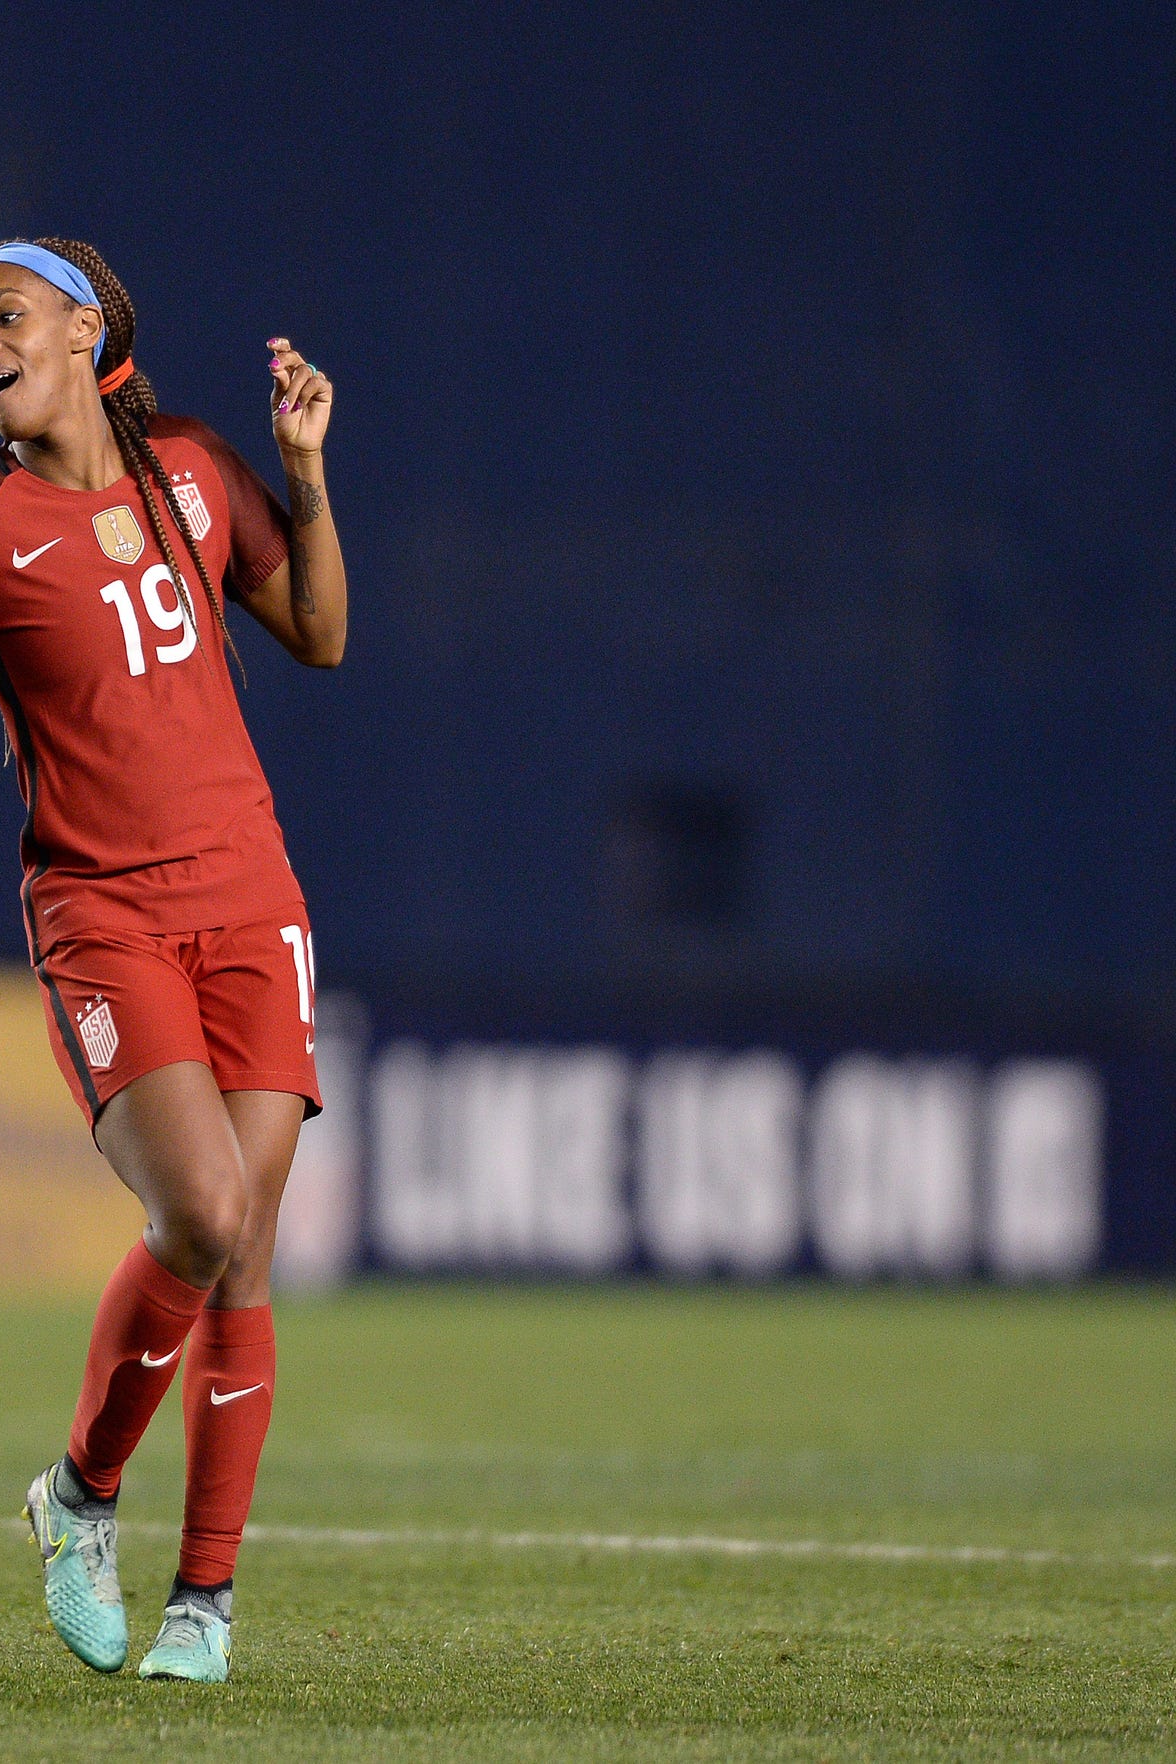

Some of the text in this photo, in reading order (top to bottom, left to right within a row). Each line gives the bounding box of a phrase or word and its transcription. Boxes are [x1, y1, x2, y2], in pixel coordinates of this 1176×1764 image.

[114, 542, 135, 555] FIFA
[99, 564, 197, 677] 19
[279, 924, 315, 1026] 1
[82, 1007, 109, 1040] USA
